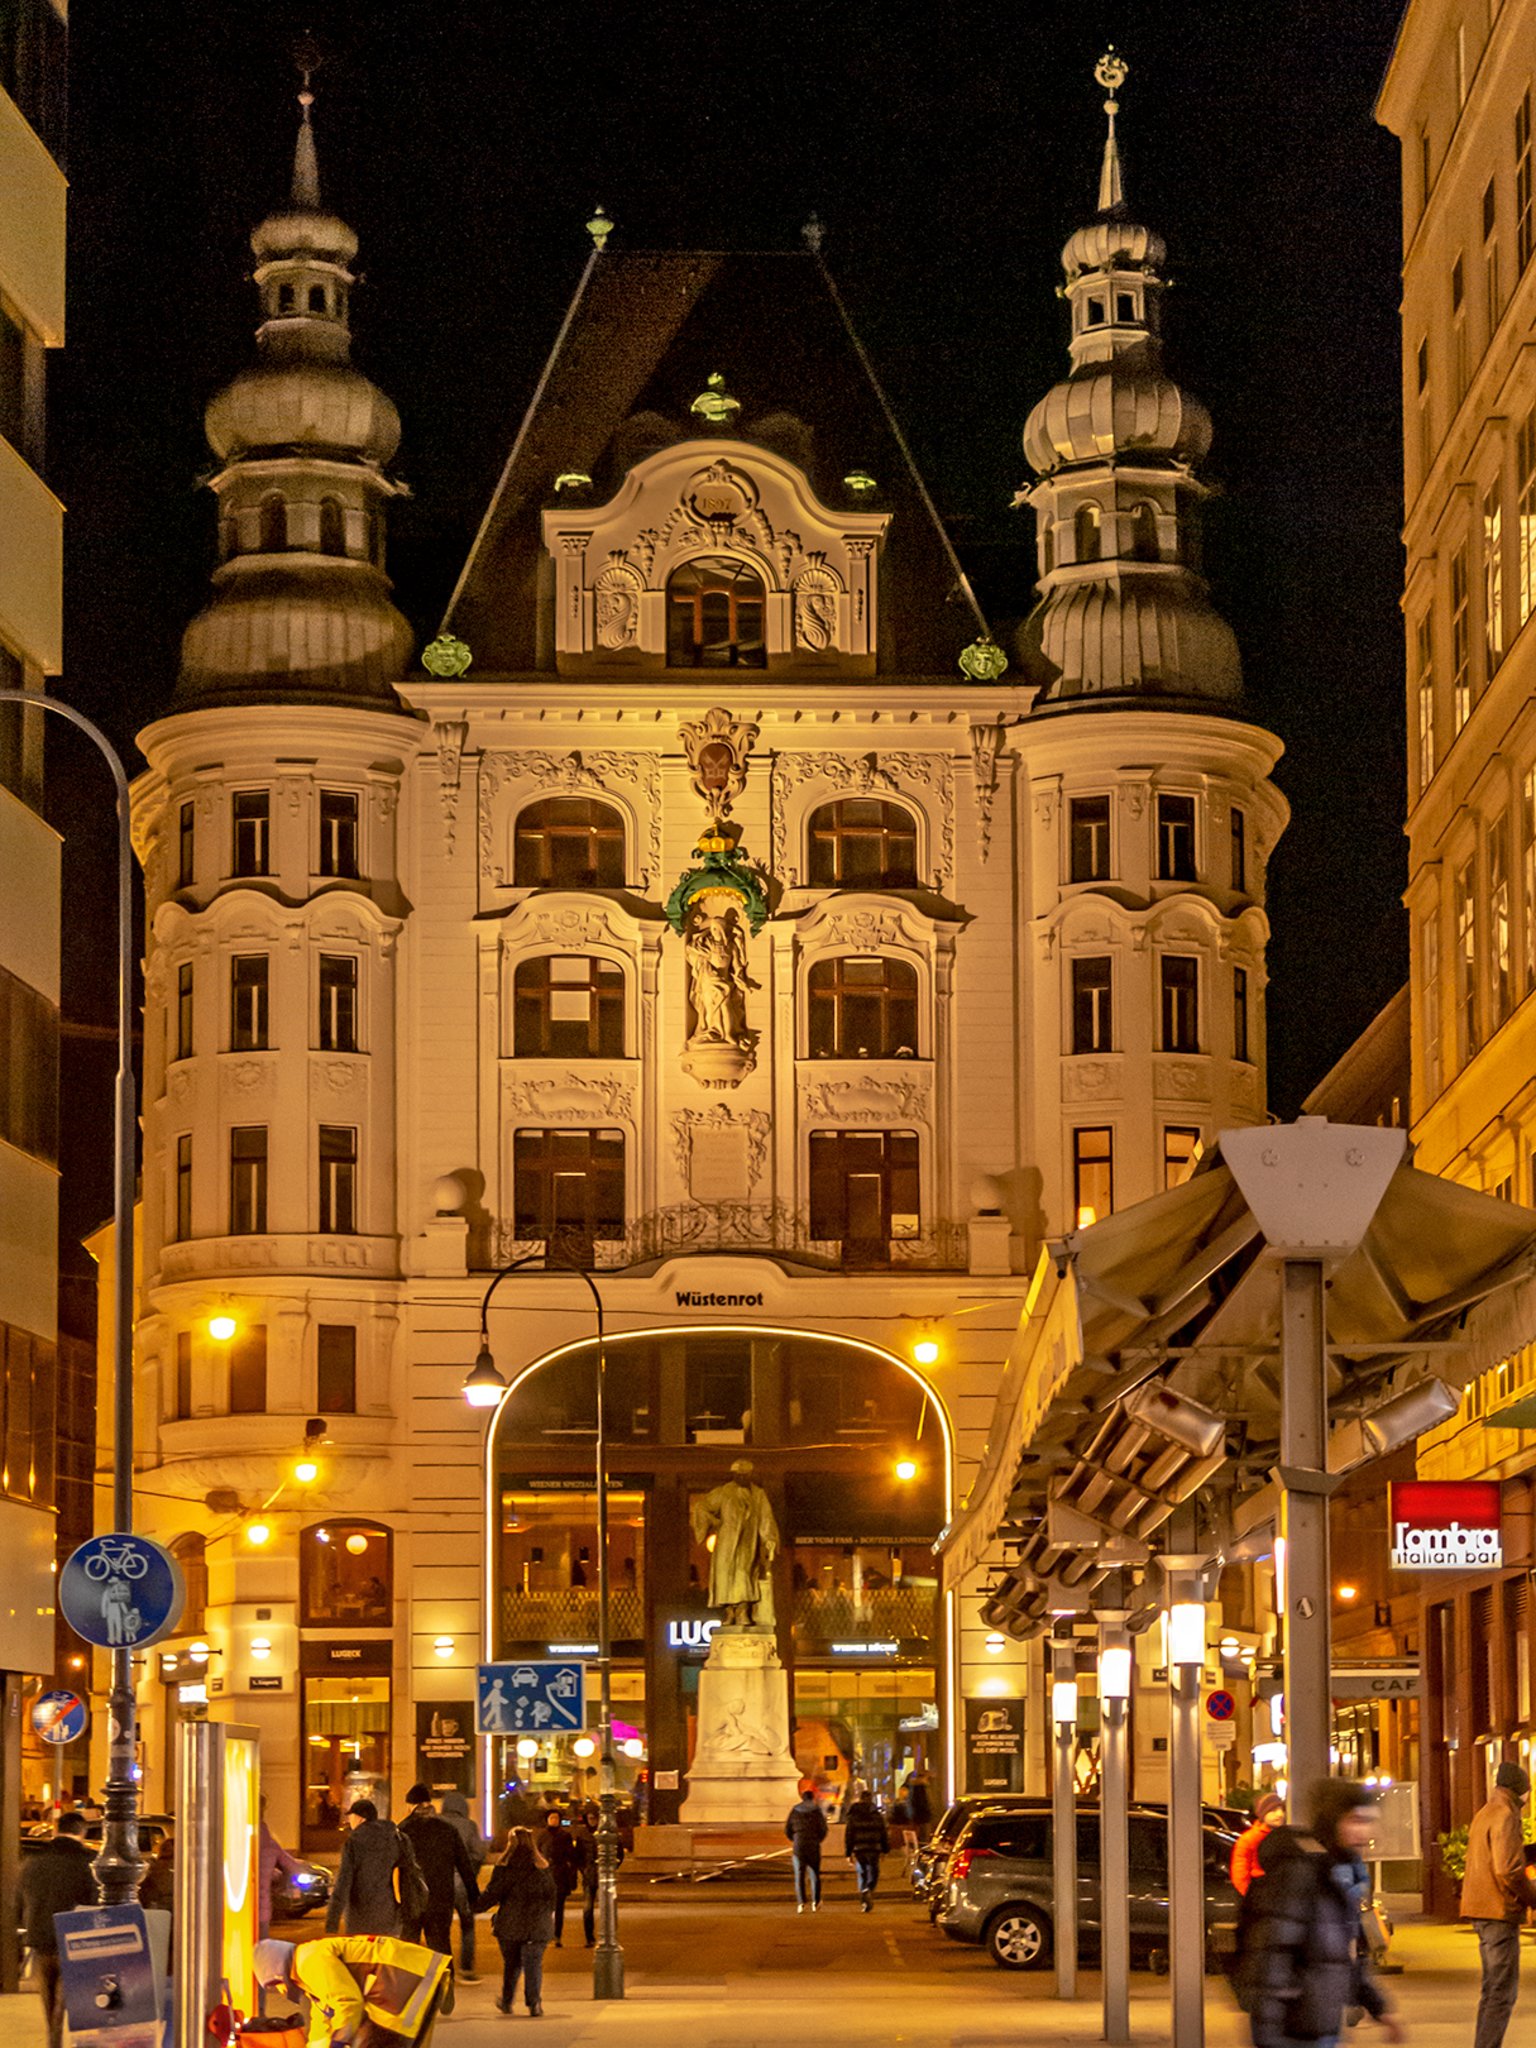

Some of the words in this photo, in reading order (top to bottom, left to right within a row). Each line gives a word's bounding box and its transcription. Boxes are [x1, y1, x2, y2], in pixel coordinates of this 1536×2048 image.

[702, 498, 732, 511] 1897
[675, 1291, 764, 1307] Wüstenrot
[528, 1480, 562, 1489] WIENER
[795, 1536, 814, 1545] BIER
[815, 1536, 834, 1545] VOM
[835, 1536, 853, 1545] FASS
[1397, 1548, 1457, 1565] italian
[1465, 1549, 1498, 1565] bar
[331, 1649, 362, 1658] LUGECK
[1371, 1679, 1418, 1692] CAF
